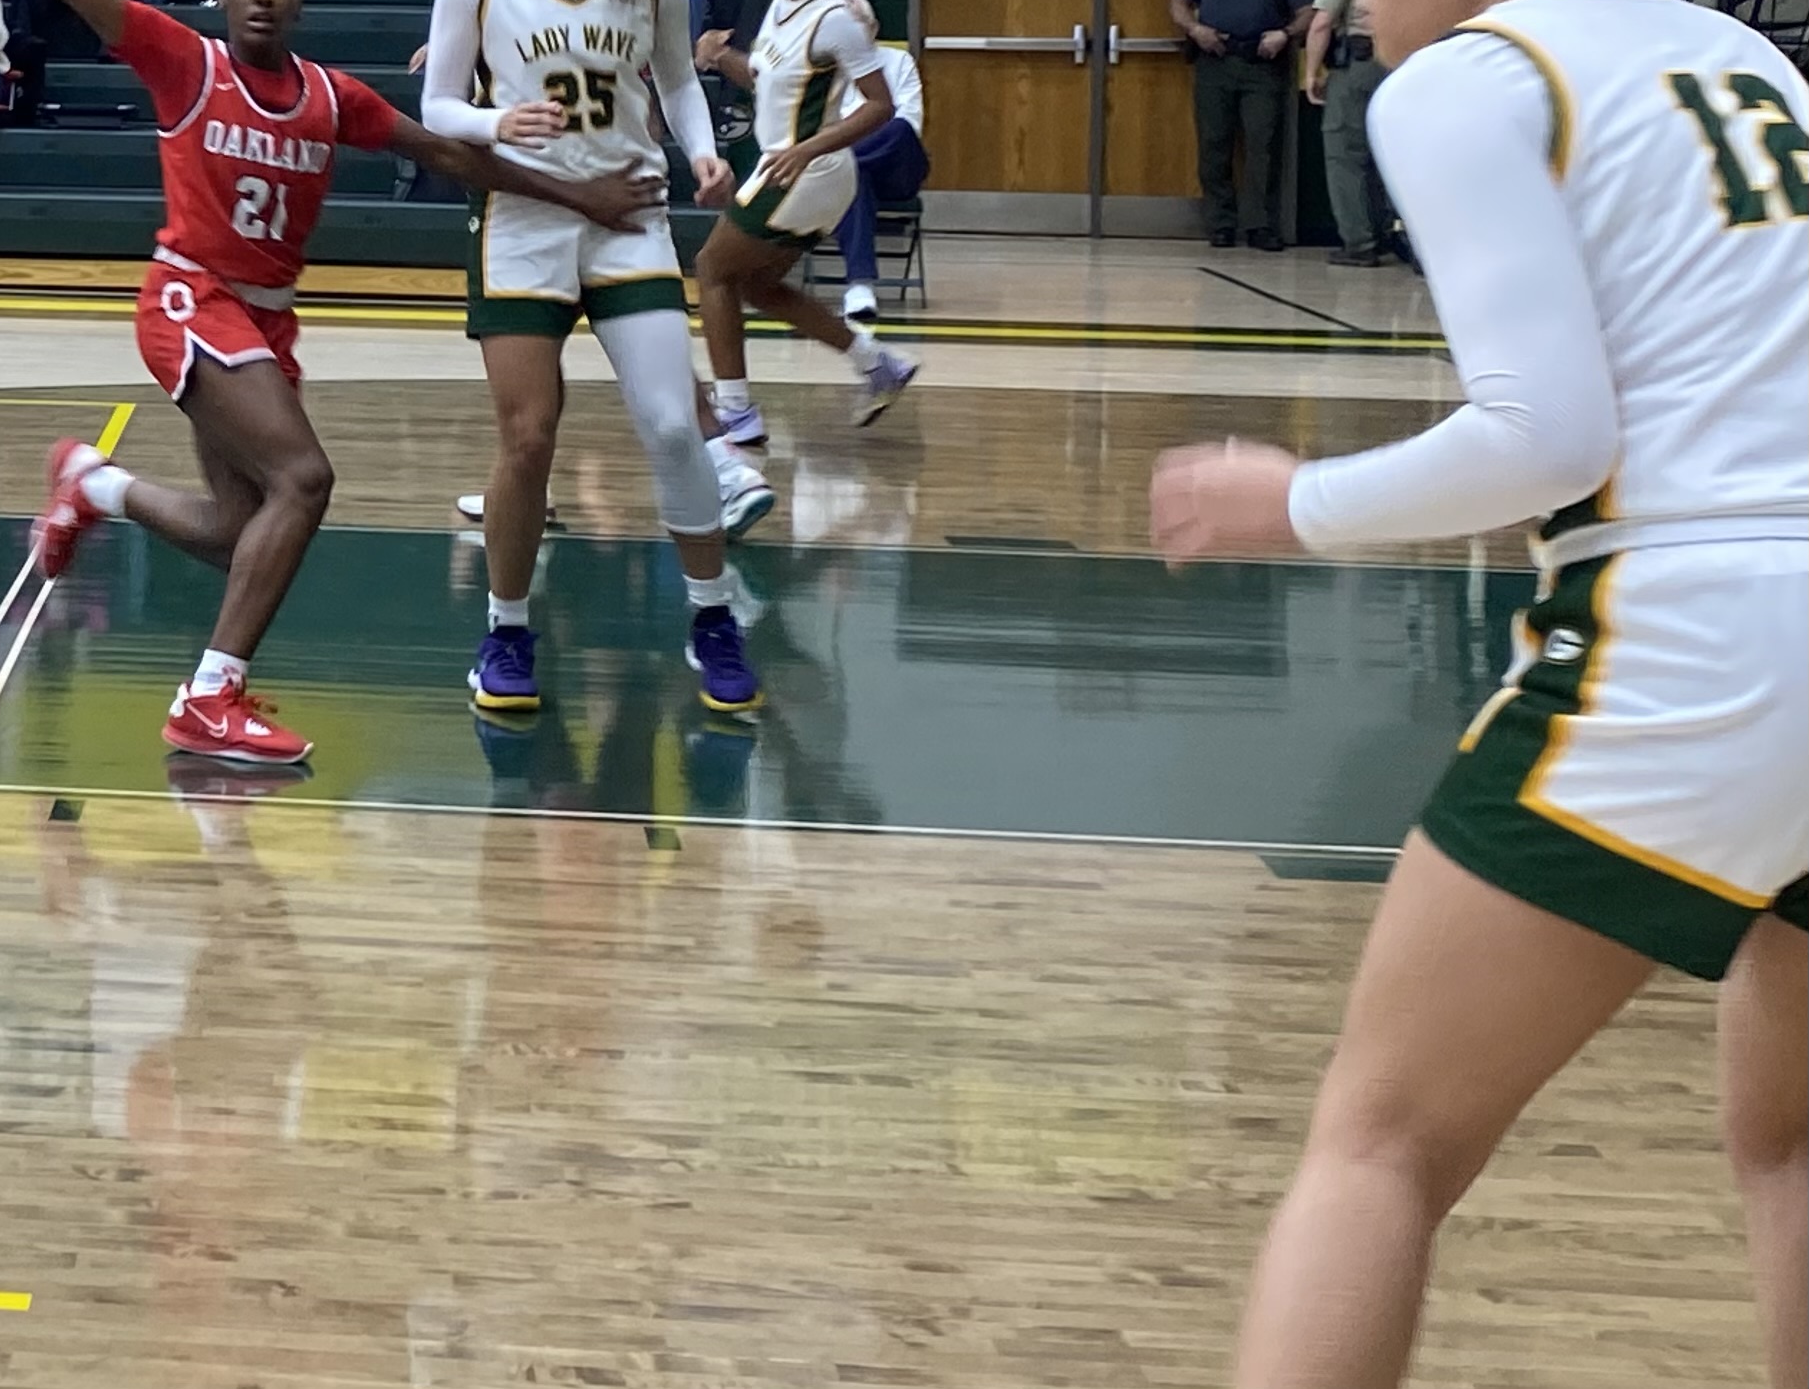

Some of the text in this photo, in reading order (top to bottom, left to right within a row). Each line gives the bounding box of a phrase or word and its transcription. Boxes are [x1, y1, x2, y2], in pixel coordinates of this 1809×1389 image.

[514, 23, 638, 63] LADY WAVE
[203, 119, 331, 174] OAKLAND
[230, 175, 289, 242] 21
